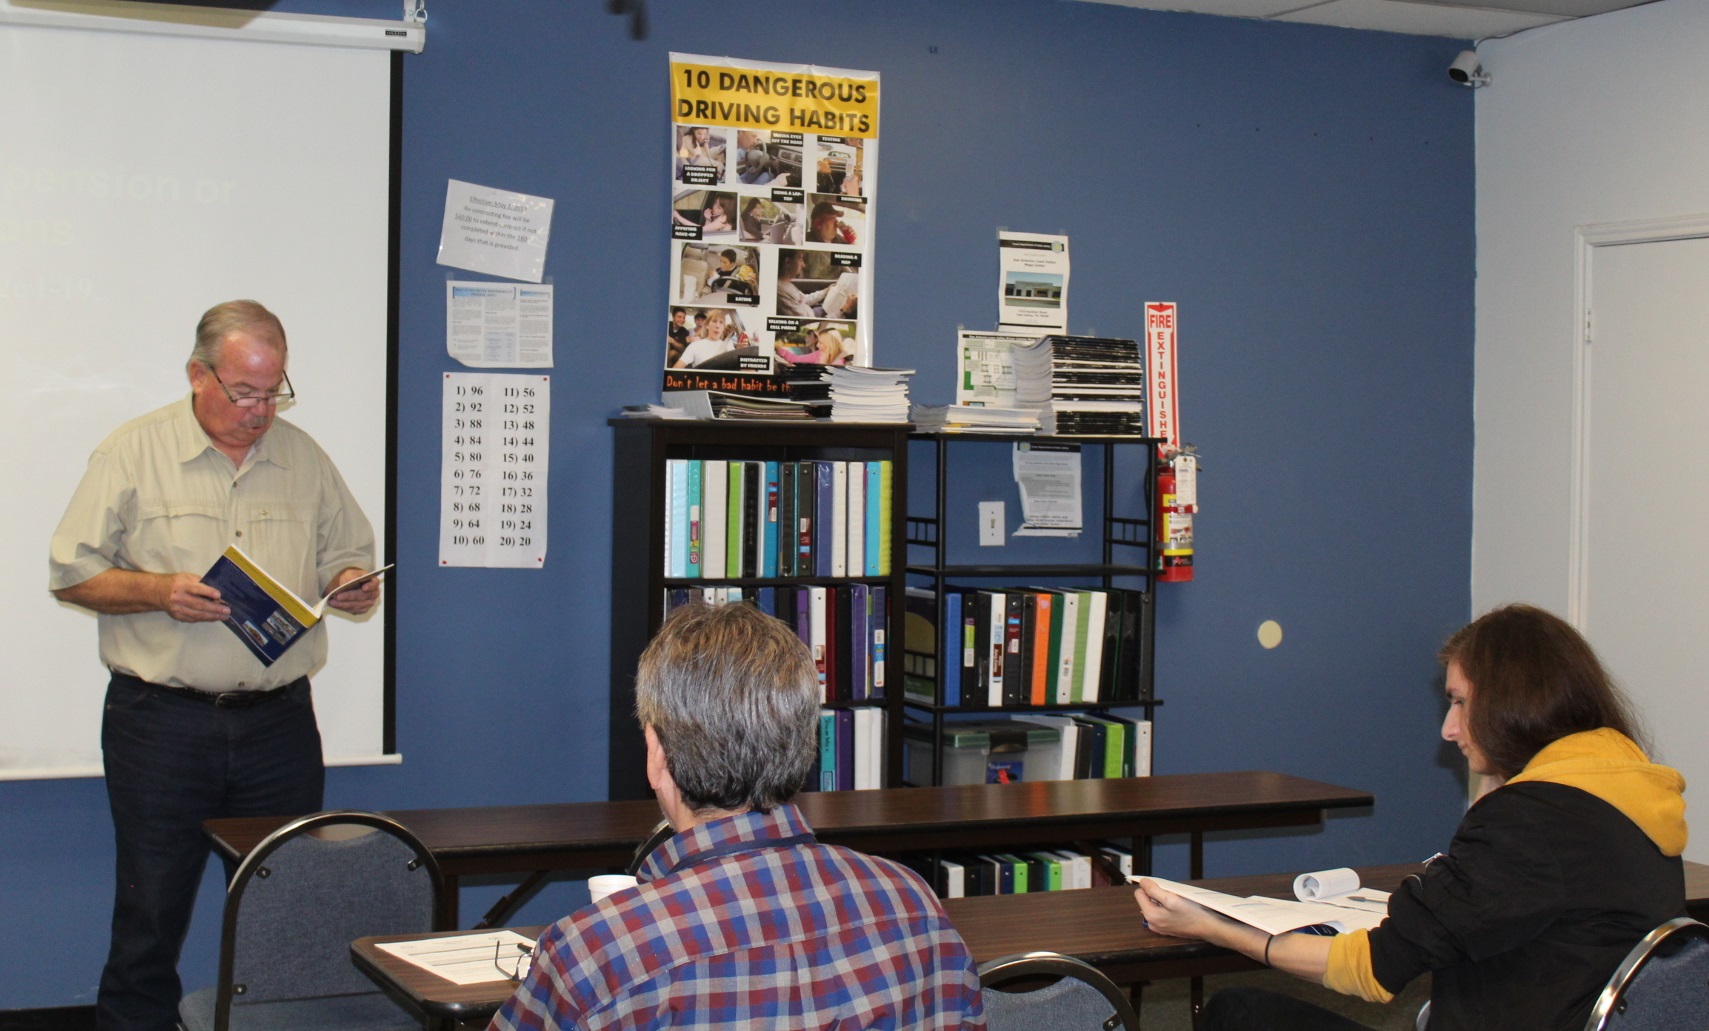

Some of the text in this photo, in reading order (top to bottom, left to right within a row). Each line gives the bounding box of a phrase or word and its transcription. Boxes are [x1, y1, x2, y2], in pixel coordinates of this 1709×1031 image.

[683, 69, 867, 103] 10 DANGEROUS
[677, 98, 870, 133] DRIVING HABITS
[1150, 314, 1172, 328] FIRE
[666, 374, 692, 389] Don't
[696, 376, 709, 389] let
[712, 381, 718, 389] a
[721, 377, 738, 390] bad
[741, 378, 764, 391] habit
[766, 379, 778, 391] be
[457, 386, 483, 396] 1) 96
[505, 388, 534, 397] 11) 56
[456, 402, 482, 412] 2) 92
[505, 404, 534, 414] 12) 52
[455, 419, 481, 429] 3) 88
[504, 421, 534, 430] 13) 48
[455, 436, 481, 445] 4) 84
[504, 437, 534, 447] 14) 44
[455, 452, 481, 462] 5) 80
[504, 454, 534, 463] 15) 40
[454, 470, 481, 479] 6) 76
[504, 471, 533, 480] 16) 36
[454, 486, 480, 496] 7) 72
[503, 488, 532, 497] 17) 32
[454, 503, 480, 512] 8) 68
[502, 504, 532, 513] 18) 28
[453, 519, 479, 529] 9) 64
[502, 521, 531, 530] 19) 24
[454, 536, 484, 545] 10) 60
[500, 537, 531, 547] 20) 20
